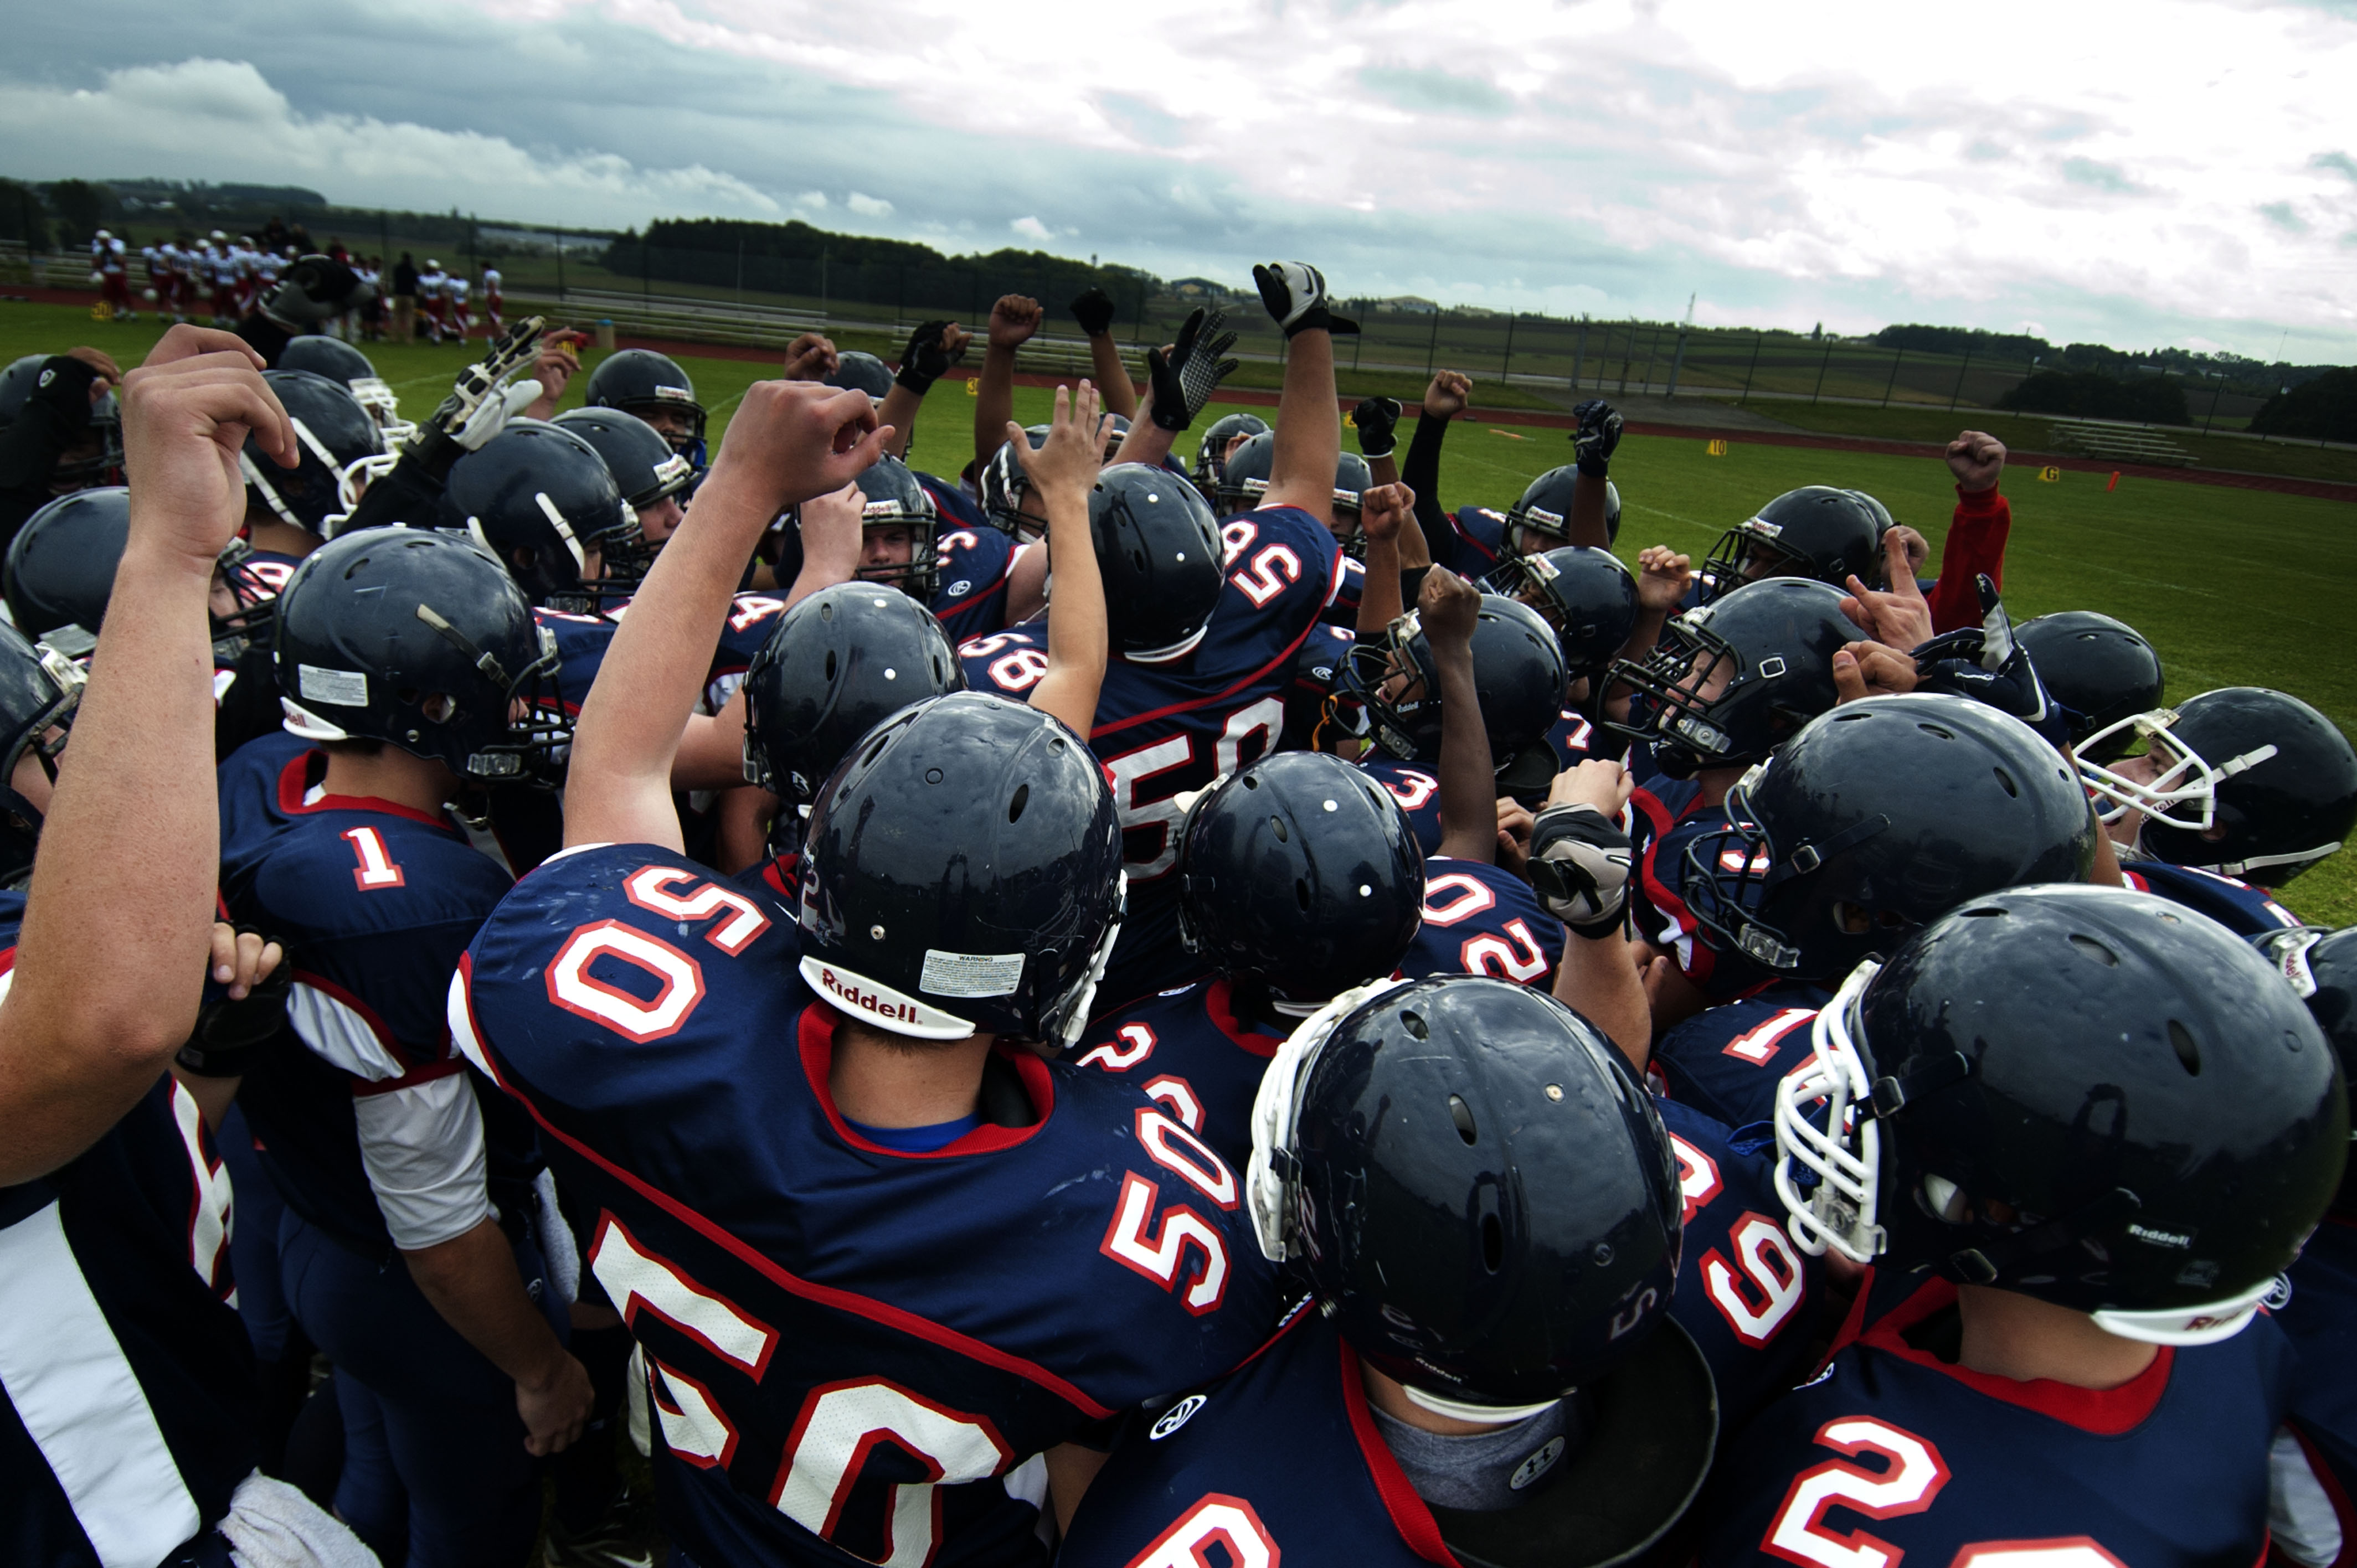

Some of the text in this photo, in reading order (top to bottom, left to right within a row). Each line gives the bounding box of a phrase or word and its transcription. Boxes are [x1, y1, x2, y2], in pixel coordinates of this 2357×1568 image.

[1713, 440, 1725, 454] 10
[2046, 467, 2057, 481] G
[341, 826, 405, 891] 1
[544, 864, 773, 1045] 50
[822, 968, 917, 1024] Riddell
[1099, 1106, 1241, 1319] 50
[2128, 1223, 2191, 1248] Riddell
